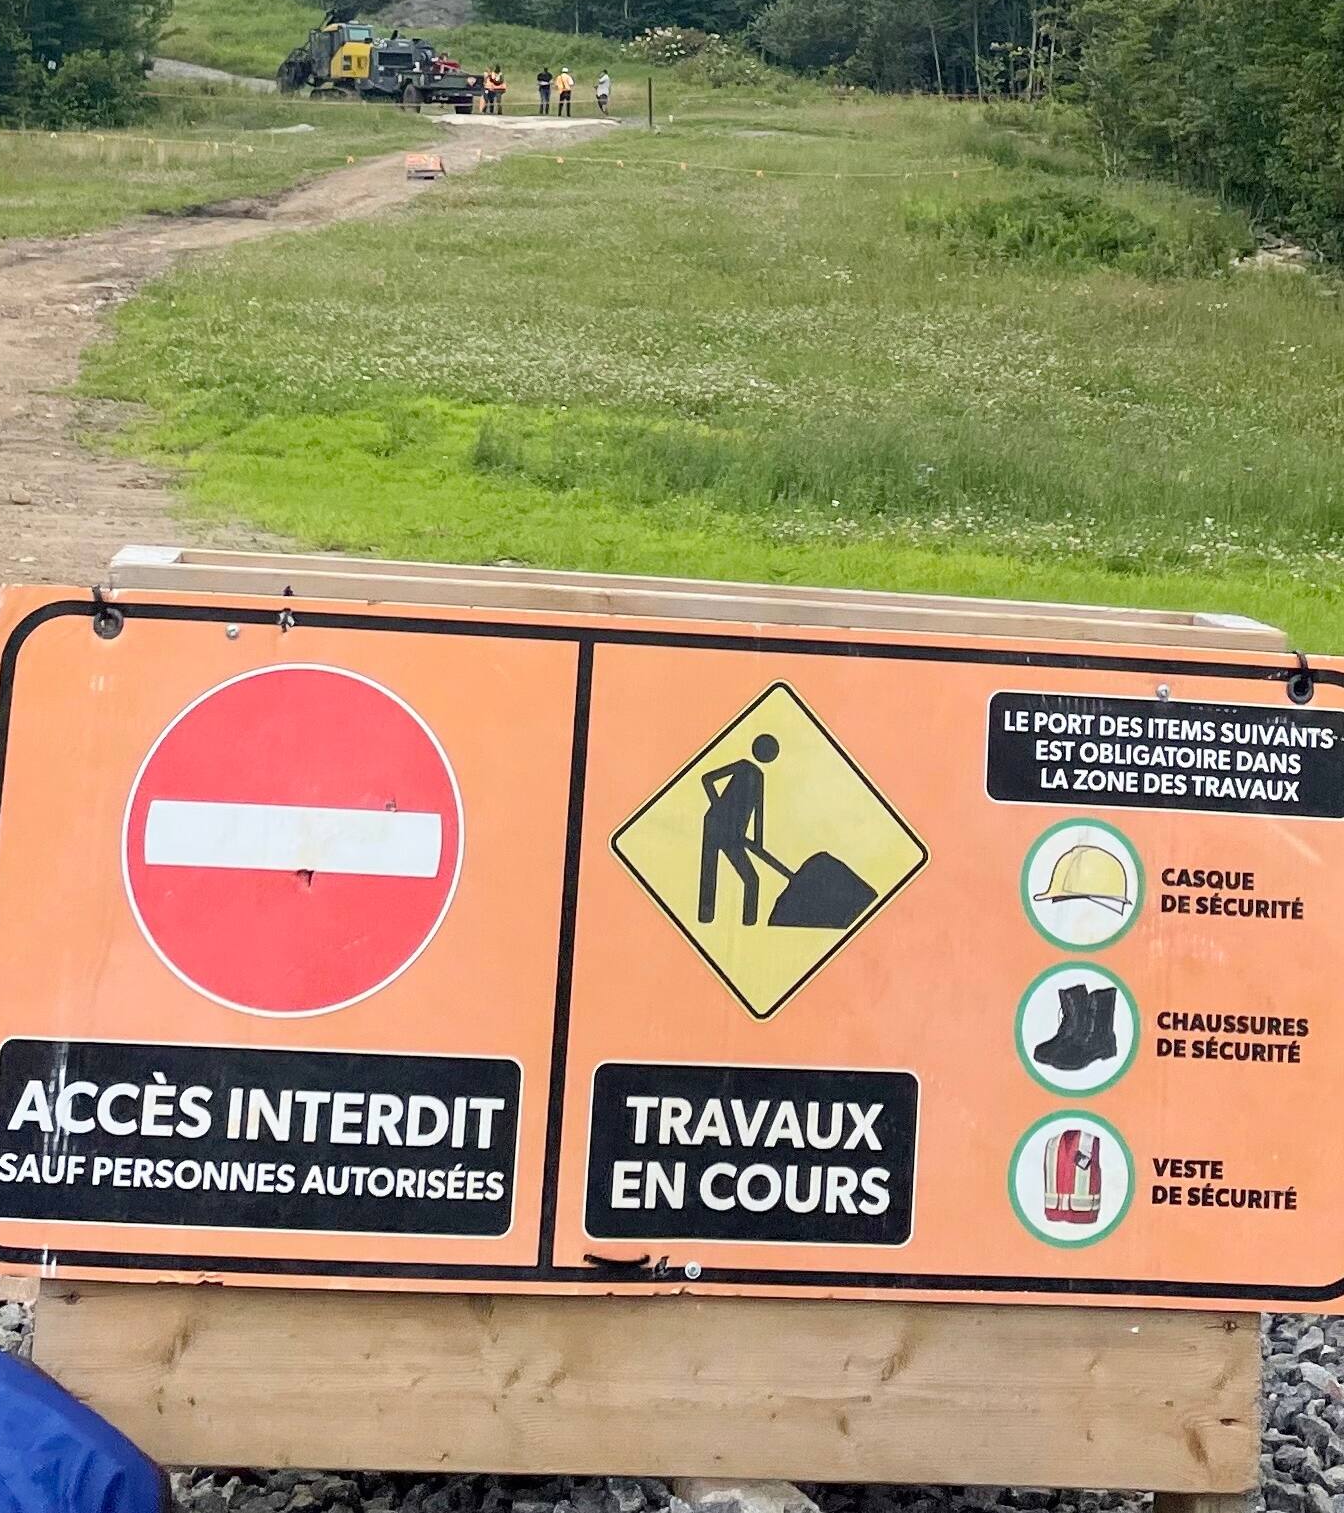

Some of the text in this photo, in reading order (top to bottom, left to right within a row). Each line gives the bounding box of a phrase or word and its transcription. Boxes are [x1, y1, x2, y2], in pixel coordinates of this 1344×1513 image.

[1004, 711, 1335, 749] LE PORT DES ITEMS SUIVANTS
[1035, 740, 1301, 774] EST OBLIGATOIRE DANS
[1040, 768, 1299, 802] LA ZONE DES TRAVAUX
[1161, 868, 1254, 890] CASQUE
[1161, 894, 1304, 920] DE SÉCURITÉ
[1157, 1011, 1309, 1036] CHAUSSURES
[1156, 1037, 1301, 1063] DE SÉCURITÉ
[7, 1072, 505, 1149] ACCÈS INTERDIT
[626, 1096, 884, 1151] TRAVAUX
[92, 1157, 295, 1194] PERSONNES
[301, 1162, 505, 1201] AUTORISÉES
[1152, 1158, 1223, 1180] VESTE
[611, 1160, 891, 1216] EN COURS
[1152, 1184, 1297, 1210] DE SÉCURITÉ
